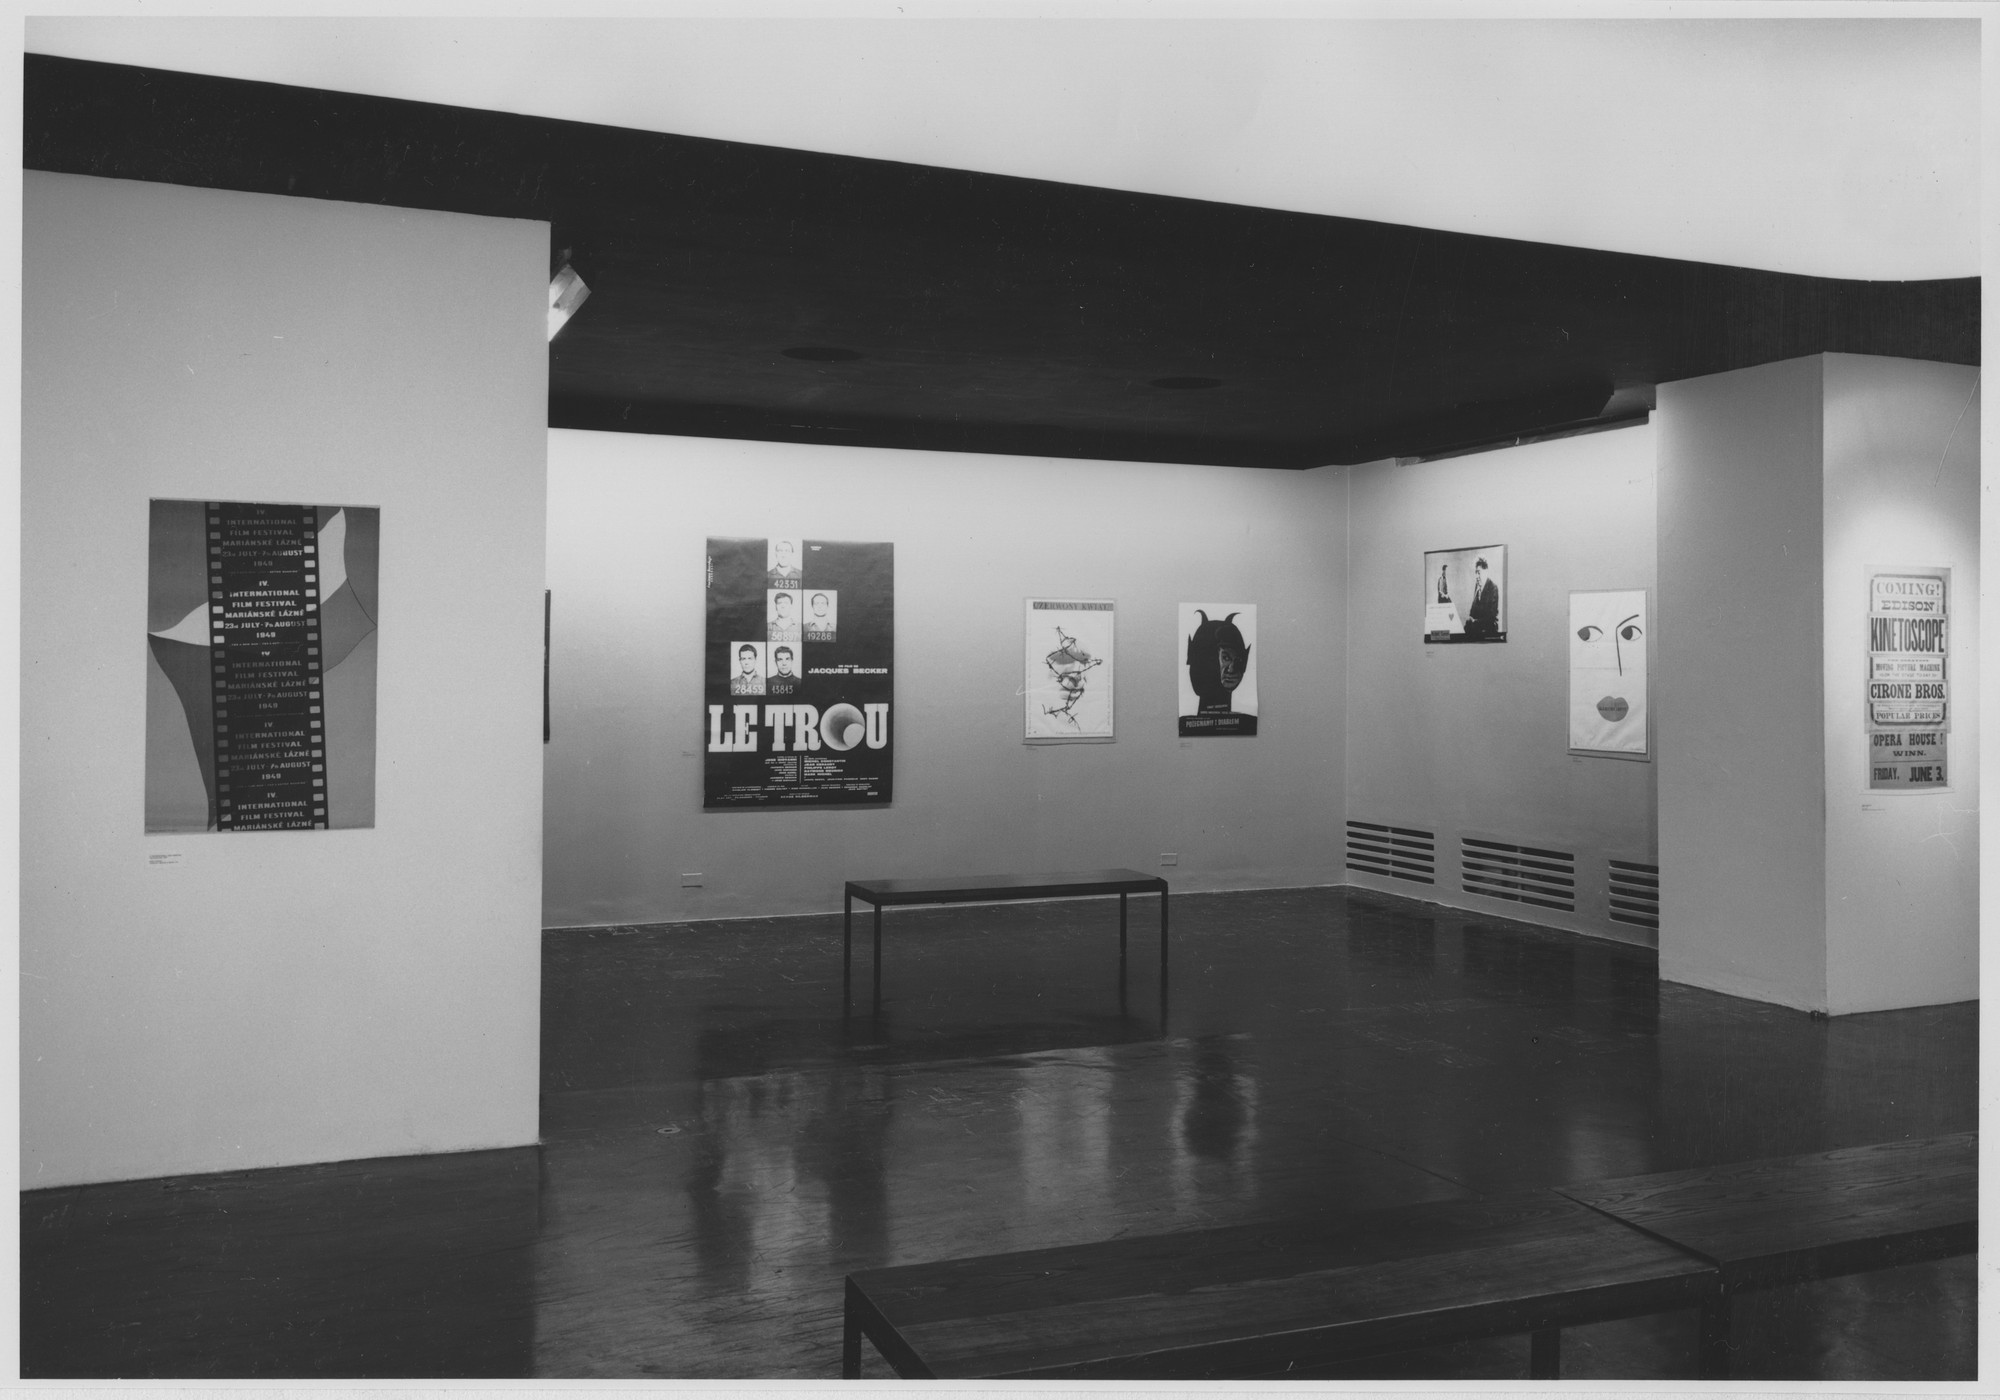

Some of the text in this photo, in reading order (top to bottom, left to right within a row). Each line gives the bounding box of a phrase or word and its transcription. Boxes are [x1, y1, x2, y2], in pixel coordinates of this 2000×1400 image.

[774, 579, 798, 589] 42331
[229, 590, 300, 598] INTERNATIONAL
[1877, 583, 1940, 596] COMING!
[1881, 600, 1935, 612] EDISON
[256, 631, 276, 639] 1949
[807, 632, 832, 641] 19286
[1871, 617, 1945, 653] KINETOSCOPE
[232, 660, 302, 669] INTERNATIONAL
[277, 691, 308, 699] AUGUST
[1871, 683, 1945, 699] CIRONE BROS.
[1876, 712, 1941, 720] POPULAR PRICES
[708, 703, 889, 752] LE TROU
[235, 730, 306, 740] INTERNATIONAL
[1873, 734, 1902, 747] OPERA
[1909, 733, 1937, 746] HOUSE
[261, 741, 302, 749] FESTIVAL
[1909, 766, 1933, 782] JUNE
[237, 800, 308, 811] INTERNATIONAL
[264, 811, 305, 819] FESTIVAL
